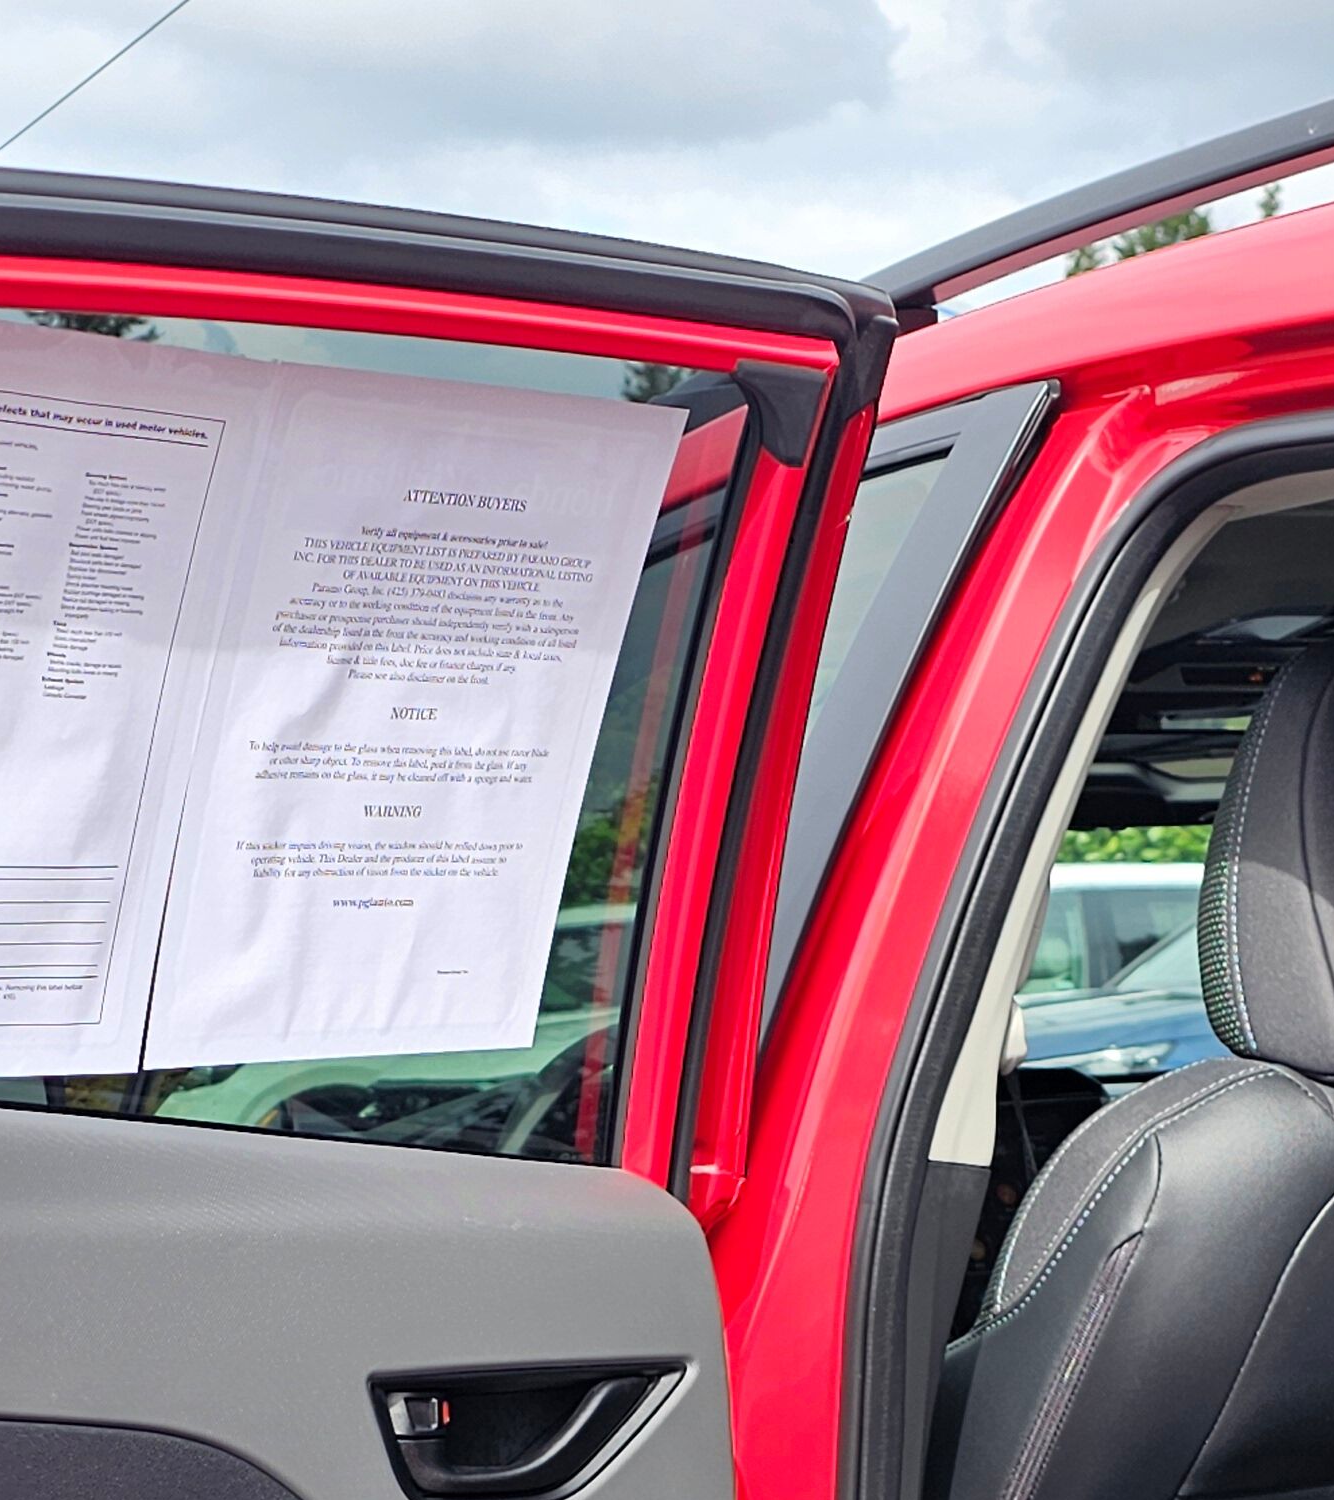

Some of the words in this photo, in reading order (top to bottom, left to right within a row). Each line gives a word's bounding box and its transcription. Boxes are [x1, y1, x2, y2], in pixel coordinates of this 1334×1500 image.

[403, 489, 476, 507] ATTENTION
[476, 495, 527, 512] BUYERS
[390, 706, 438, 720] NOTICE
[364, 805, 422, 817] WARNING
